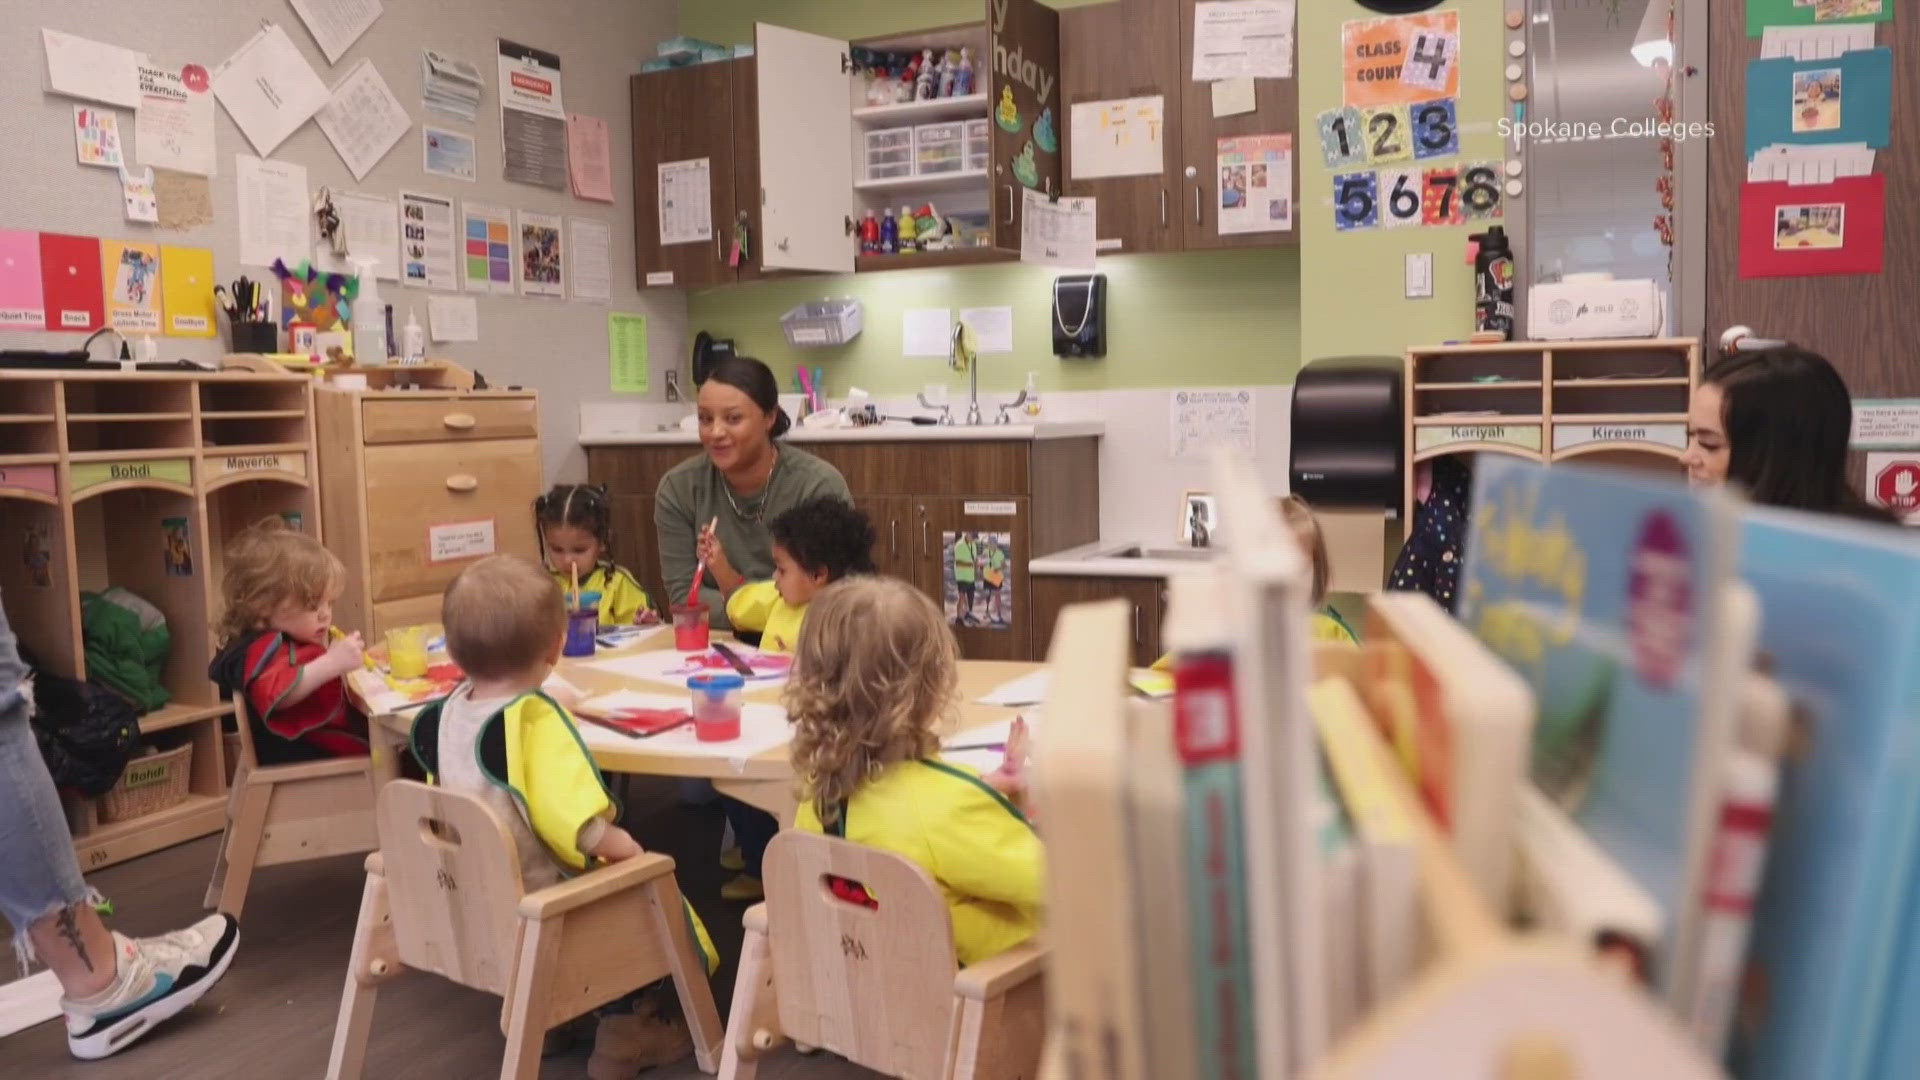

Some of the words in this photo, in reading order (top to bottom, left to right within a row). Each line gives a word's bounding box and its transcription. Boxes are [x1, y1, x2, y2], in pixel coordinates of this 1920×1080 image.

[1356, 40, 1402, 58] CLASS
[1413, 35, 1447, 81] 4
[138, 66, 164, 77] THANK
[167, 72, 182, 82] YOU
[993, 33, 1054, 106] hday
[1356, 65, 1402, 82] COUNT
[140, 83, 188, 98] EVERYTHING
[1331, 116, 1350, 157] 1
[1368, 113, 1401, 157] 2
[1418, 105, 1451, 150] 3
[1339, 179, 1373, 222] 5
[1389, 174, 1420, 219] 6
[1429, 175, 1457, 218] 7
[1462, 167, 1500, 211] 8
[24, 311, 43, 320] Time
[64, 313, 86, 321] Snack
[1451, 426, 1505, 442] Kariyah
[1592, 427, 1646, 440] Kireem
[110, 464, 150, 479] Bohdi
[227, 456, 280, 471] Maverick
[1891, 496, 1916, 507] STOP
[130, 766, 165, 783] Bohdi
